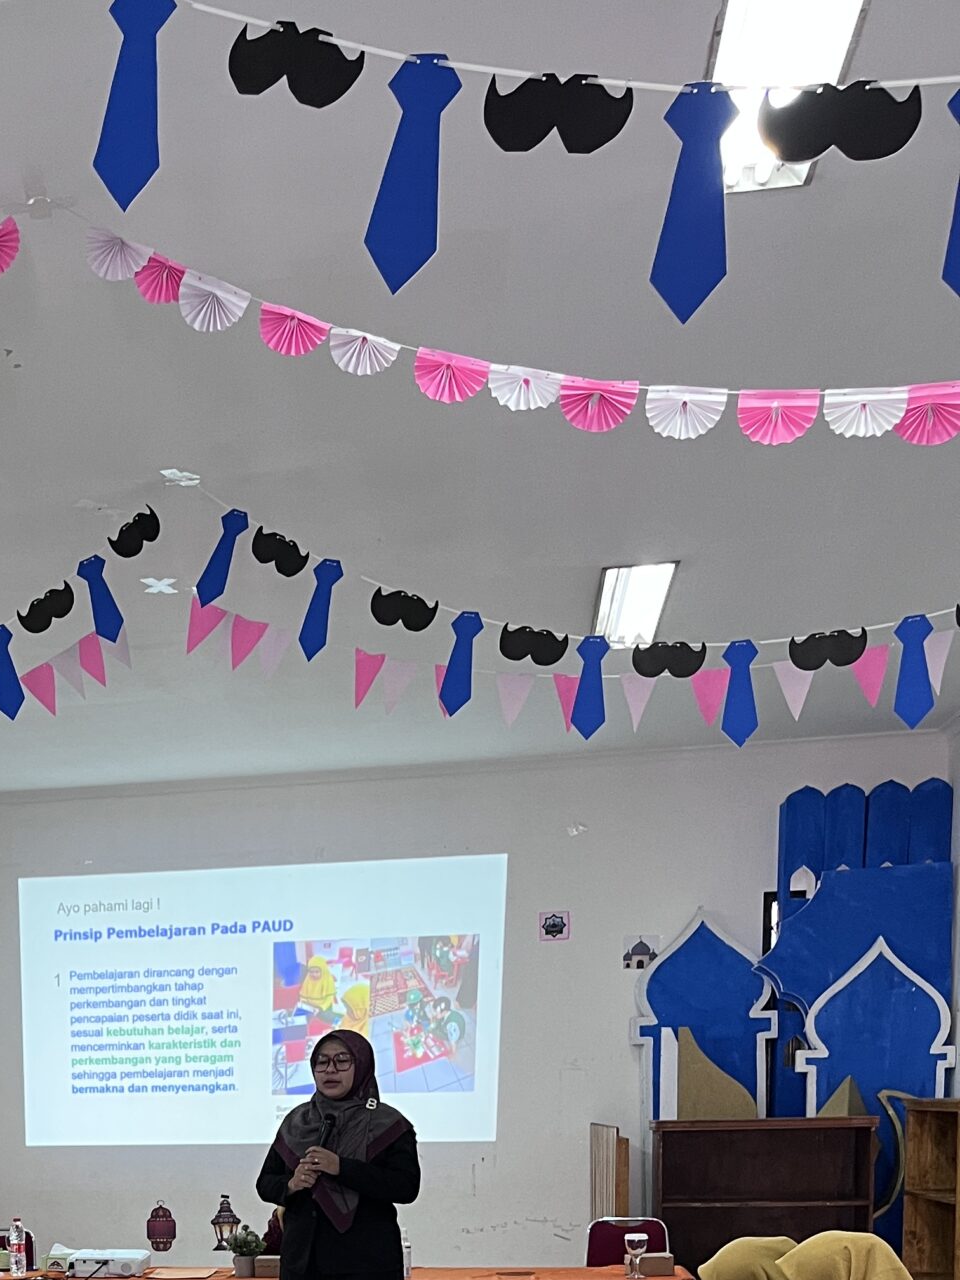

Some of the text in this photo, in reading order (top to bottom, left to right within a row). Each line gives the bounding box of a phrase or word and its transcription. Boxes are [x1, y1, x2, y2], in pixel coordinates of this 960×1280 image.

[56, 902, 80, 917] Ayo
[83, 899, 128, 916] pahami
[131, 898, 153, 913] lagi
[53, 919, 294, 942] Prinsip Pembelajaran Pada PAUD
[69, 965, 238, 982] Pembelajaran dirancang dengan
[69, 981, 204, 996] mempertimbangkan tahap
[70, 995, 207, 1011] perkembangan dan tingkat
[70, 1011, 130, 1026] pencapaian
[132, 1011, 171, 1024] peserta
[173, 1009, 198, 1021] didik
[200, 1009, 224, 1020] saat
[70, 1027, 104, 1038] sesuai
[106, 1025, 164, 1037] kebutuhan
[211, 1023, 238, 1034] serta
[70, 1038, 241, 1052] mencerminkan karakteristik dan
[71, 1052, 234, 1068] perkembangan yang beragam
[71, 1066, 234, 1082] sehingga pembelajaran menjadi
[71, 1083, 125, 1095] bermakna
[127, 1083, 148, 1094] dan
